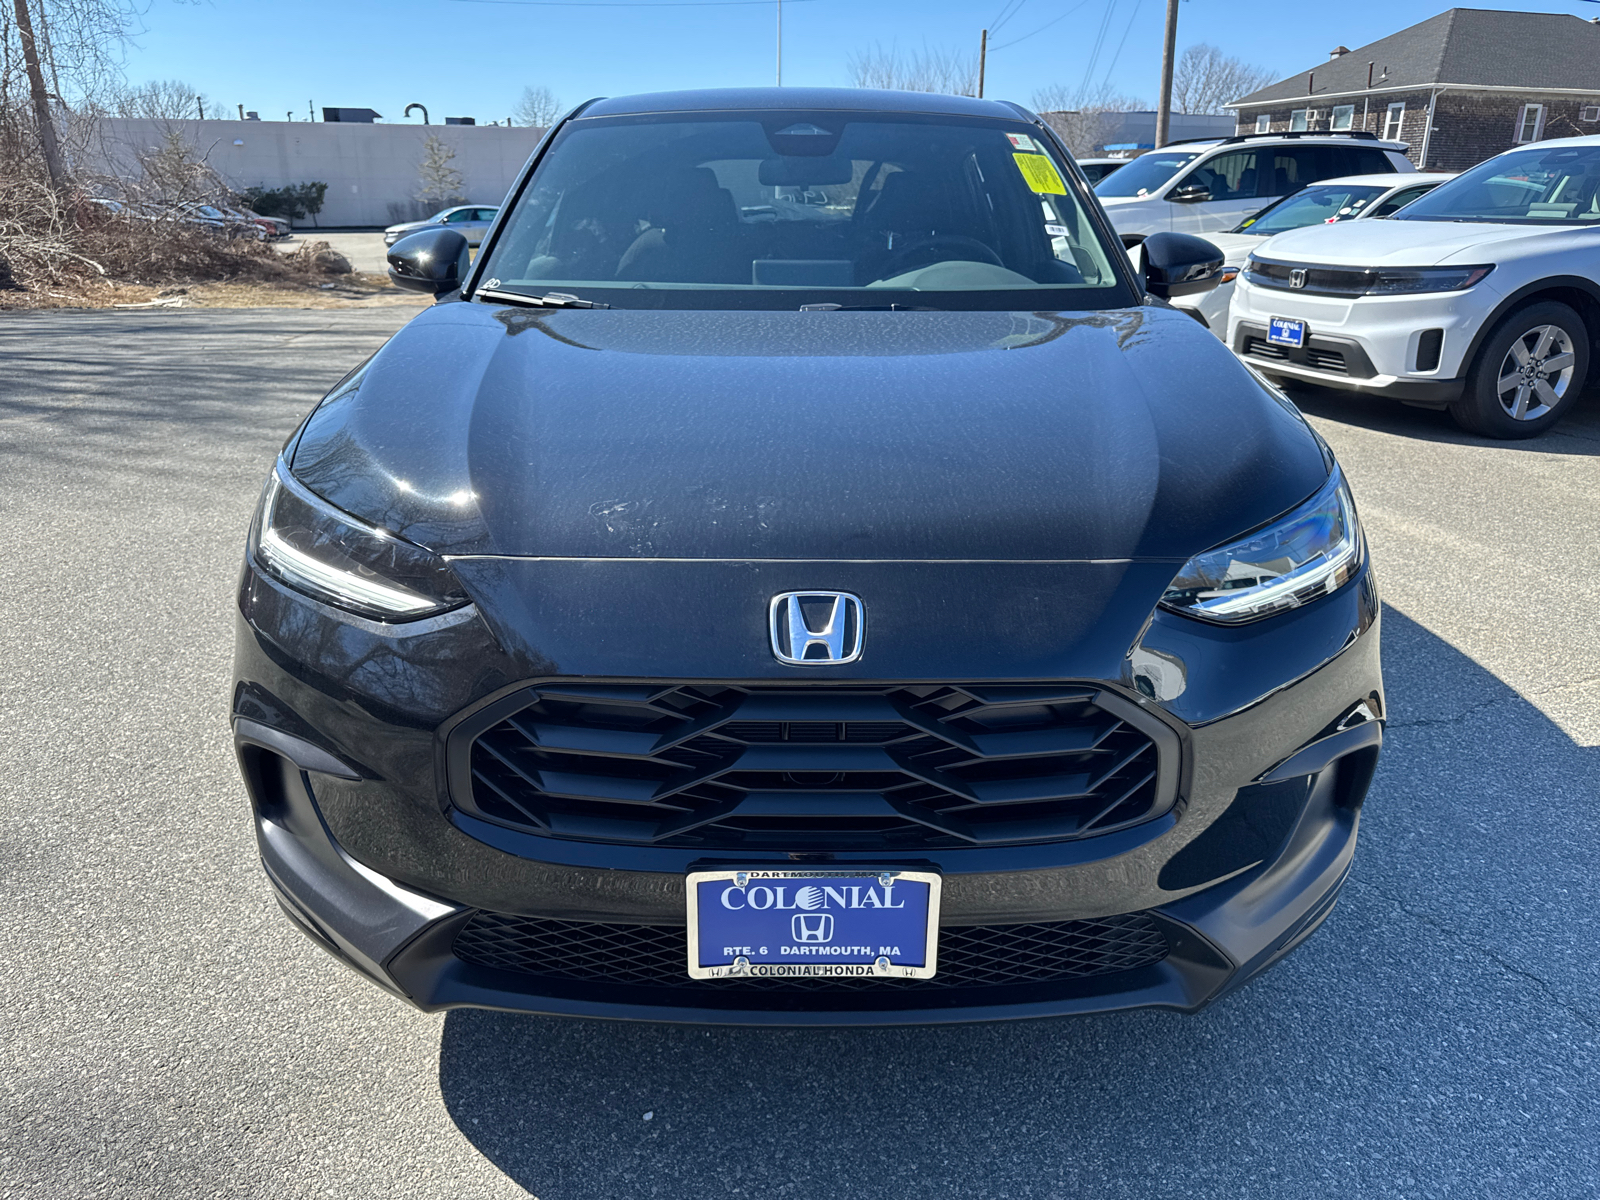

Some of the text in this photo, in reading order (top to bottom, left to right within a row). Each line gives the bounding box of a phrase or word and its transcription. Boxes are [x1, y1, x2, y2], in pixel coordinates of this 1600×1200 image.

[721, 886, 904, 910] COLONIAL
[723, 946, 901, 957] RTE. 6 DARTMOUTH, MA
[750, 966, 875, 976] COLONIAL HONDA
